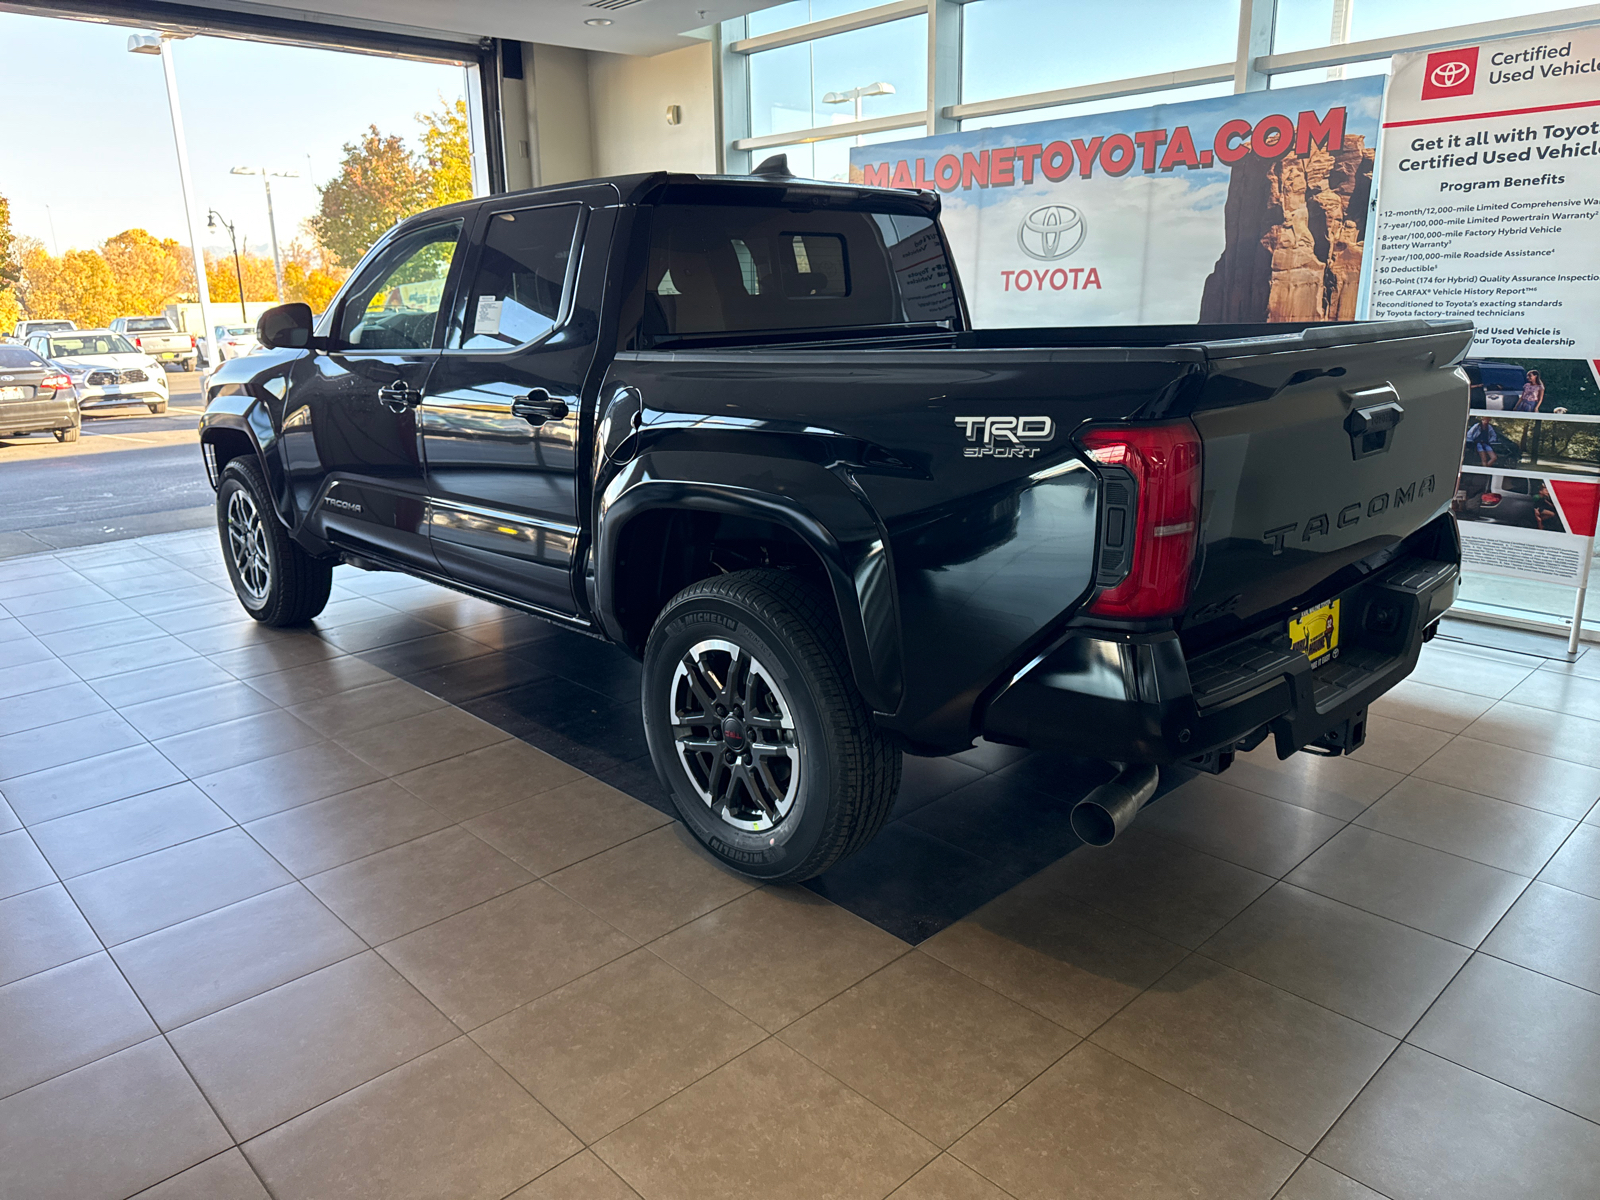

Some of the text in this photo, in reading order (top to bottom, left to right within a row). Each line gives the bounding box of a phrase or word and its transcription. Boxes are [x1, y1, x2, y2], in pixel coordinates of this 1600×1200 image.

[1491, 41, 1571, 66] Certified
[1489, 66, 1534, 84] Used
[1411, 121, 1600, 151] Get it all with Toyot
[863, 106, 1347, 192] MALONETOYOTA.COM
[1398, 141, 1600, 172] Certified Used Vehicl
[1440, 174, 1565, 193] Program Benefits
[1384, 198, 1600, 218] 12-month/12,000-mile Limited Comprehensive Wa
[1383, 217, 1465, 230] 7-year/100,000-mile
[1467, 216, 1499, 224] Limited
[1501, 213, 1550, 222] Powertrain
[1464, 229, 1496, 237] Factory
[1498, 227, 1527, 236] Hybrid
[1529, 225, 1562, 234] Vehicle
[1381, 243, 1410, 251] Battery
[1380, 251, 1462, 263] 7-year/100,000-mile
[1463, 250, 1503, 259] Roadside
[1001, 267, 1102, 292] TOYOTA
[1447, 275, 1478, 284] Hybrid)
[1479, 275, 1510, 283] Quality
[1558, 273, 1600, 282] Inspectio
[1463, 288, 1494, 296] History
[1376, 300, 1433, 308] Reconditioned
[1479, 300, 1517, 308] exacting
[1518, 299, 1563, 307] standards
[1414, 309, 1475, 317] factory-trained
[1476, 309, 1525, 317] technicians
[1491, 327, 1514, 335] Used
[1516, 327, 1551, 335] Vehicle
[1552, 327, 1561, 335] is
[1490, 337, 1522, 346] Toyota
[1523, 337, 1576, 347] dealership
[954, 416, 1055, 445] TRD
[963, 447, 1041, 458] SPORT
[324, 497, 362, 513] TACOMA
[1263, 474, 1436, 556] TACOMA
[684, 612, 737, 630] MICHELIN
[711, 838, 763, 863] MICHELIN
